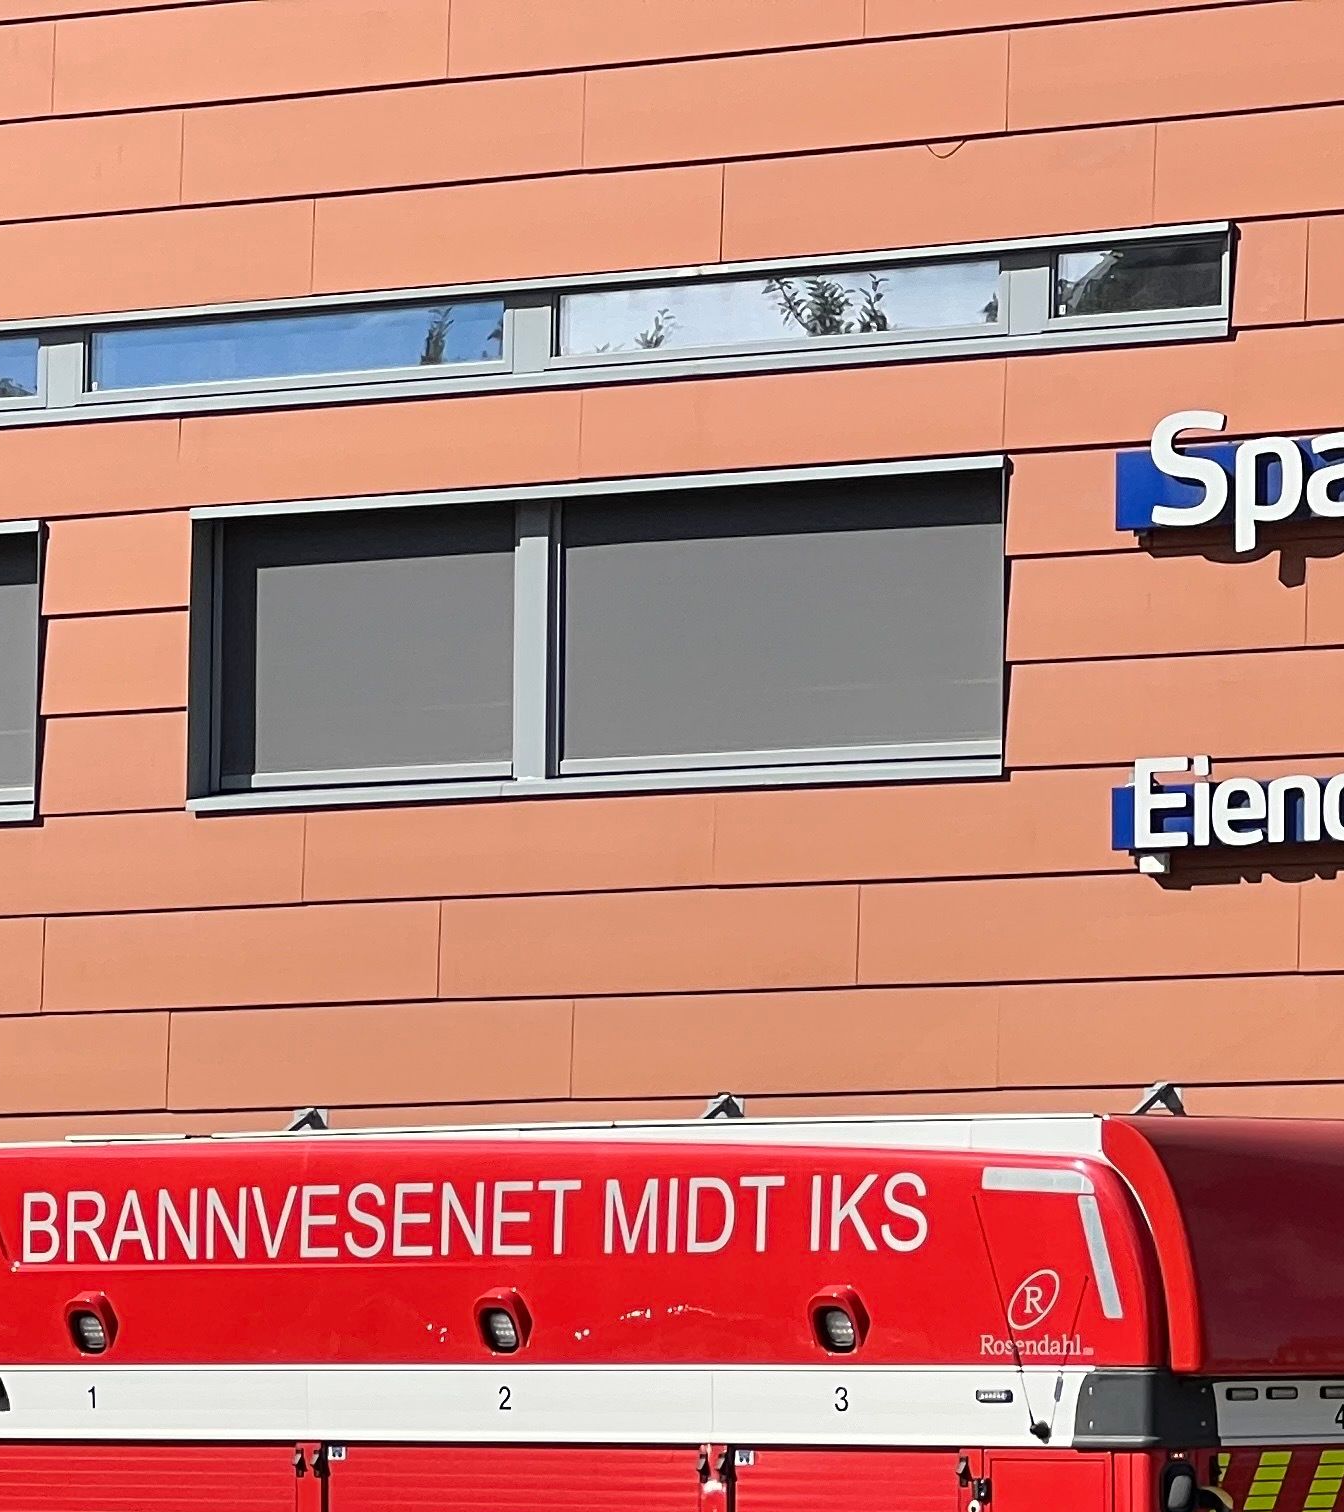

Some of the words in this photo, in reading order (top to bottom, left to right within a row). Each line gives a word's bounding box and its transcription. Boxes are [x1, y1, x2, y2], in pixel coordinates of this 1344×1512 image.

[22, 1179, 581, 1263] BRANNVESENET
[604, 1175, 785, 1255] MIDT
[810, 1172, 928, 1253] IKS
[979, 1333, 1082, 1356] Rosendahl
[87, 1386, 97, 1409] 1
[498, 1386, 512, 1411] 2
[834, 1386, 849, 1412] 3
